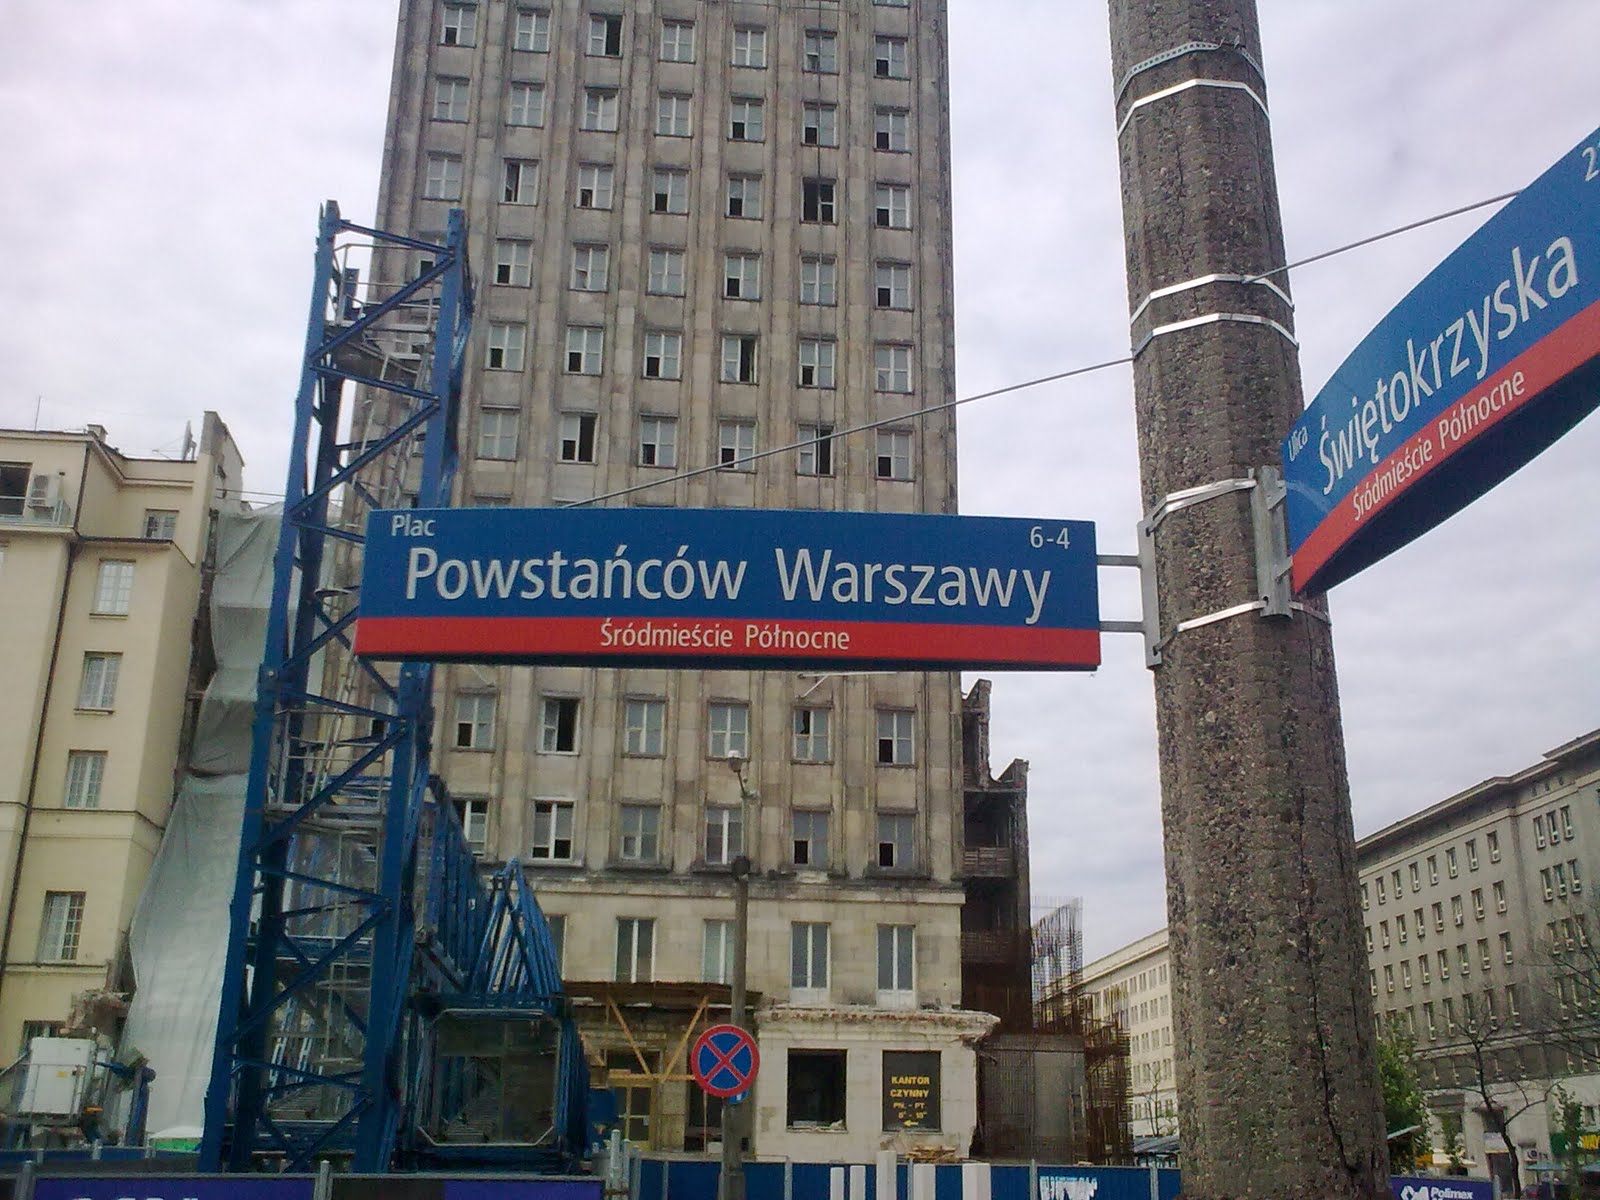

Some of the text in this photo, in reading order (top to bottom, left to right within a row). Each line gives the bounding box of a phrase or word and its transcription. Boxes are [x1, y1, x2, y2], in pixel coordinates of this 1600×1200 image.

[1582, 146, 1600, 181] 2
[1319, 236, 1579, 495] Świętokrzyska
[1288, 426, 1308, 461] Ulica
[1353, 371, 1526, 521] Śródmieście Północne
[391, 514, 435, 538] Plac
[1030, 525, 1071, 550] 6-4
[405, 544, 1052, 625] Powstańców Warszawy
[600, 617, 851, 651] Śródmieście Północne
[890, 1089, 929, 1098] CZYNNY
[891, 1076, 930, 1085] KANTOR
[1430, 1186, 1474, 1199] Polimex
